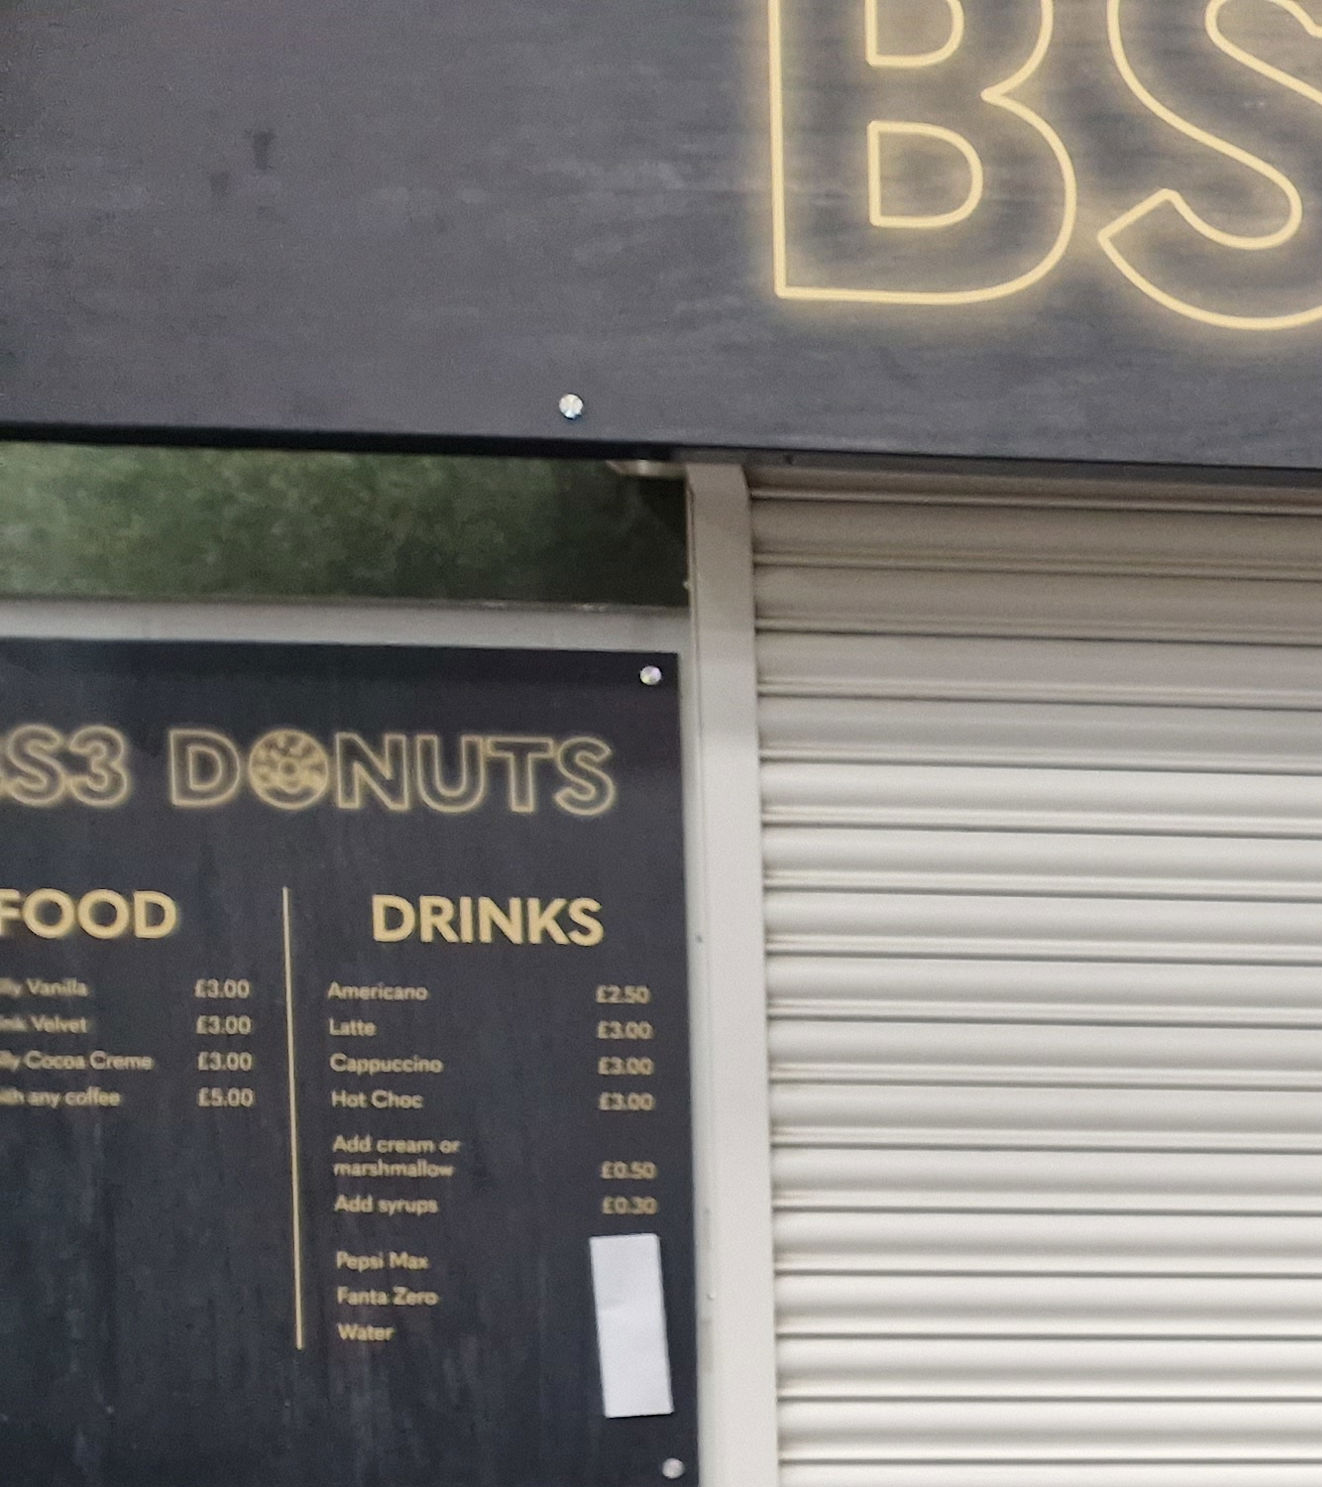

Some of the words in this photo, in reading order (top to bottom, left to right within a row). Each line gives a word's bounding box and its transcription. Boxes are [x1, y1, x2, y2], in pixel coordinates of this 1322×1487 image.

[0, 724, 128, 806] S3
[168, 728, 616, 816] DONUTS
[0, 888, 176, 939] FOOD
[372, 894, 603, 946] DRINKS
[27, 978, 89, 998] Vanilla
[195, 979, 250, 998] £3.00
[328, 982, 428, 1000] Americano
[596, 985, 649, 1003] £2.50
[31, 1016, 89, 1033] Velvet
[196, 1015, 251, 1034] £3.00
[329, 1018, 376, 1036] Latte
[597, 1021, 653, 1039] £3.00
[24, 1051, 85, 1070] Cocoa
[90, 1051, 154, 1070] Creme
[198, 1052, 252, 1070] £3.00
[330, 1053, 443, 1076] Cappuccino
[598, 1057, 653, 1075] £3.00
[24, 1092, 60, 1108] any
[65, 1087, 121, 1106] coffee
[198, 1088, 253, 1107] £5.00
[332, 1091, 366, 1108] Hot
[371, 1090, 423, 1109] Choc
[599, 1093, 655, 1111] £3.00
[334, 1135, 371, 1153] Add
[377, 1138, 433, 1153] cream
[439, 1139, 461, 1153] or
[334, 1160, 454, 1178] marshmallow
[600, 1161, 656, 1179] £0.50
[334, 1196, 372, 1213] Add
[378, 1199, 438, 1216] syrups
[602, 1197, 657, 1214] £0.30
[336, 1252, 383, 1272] Pepsi
[389, 1252, 429, 1270] Max
[337, 1287, 387, 1305] Fanta
[393, 1286, 439, 1305] Zero
[338, 1324, 396, 1341] Water
